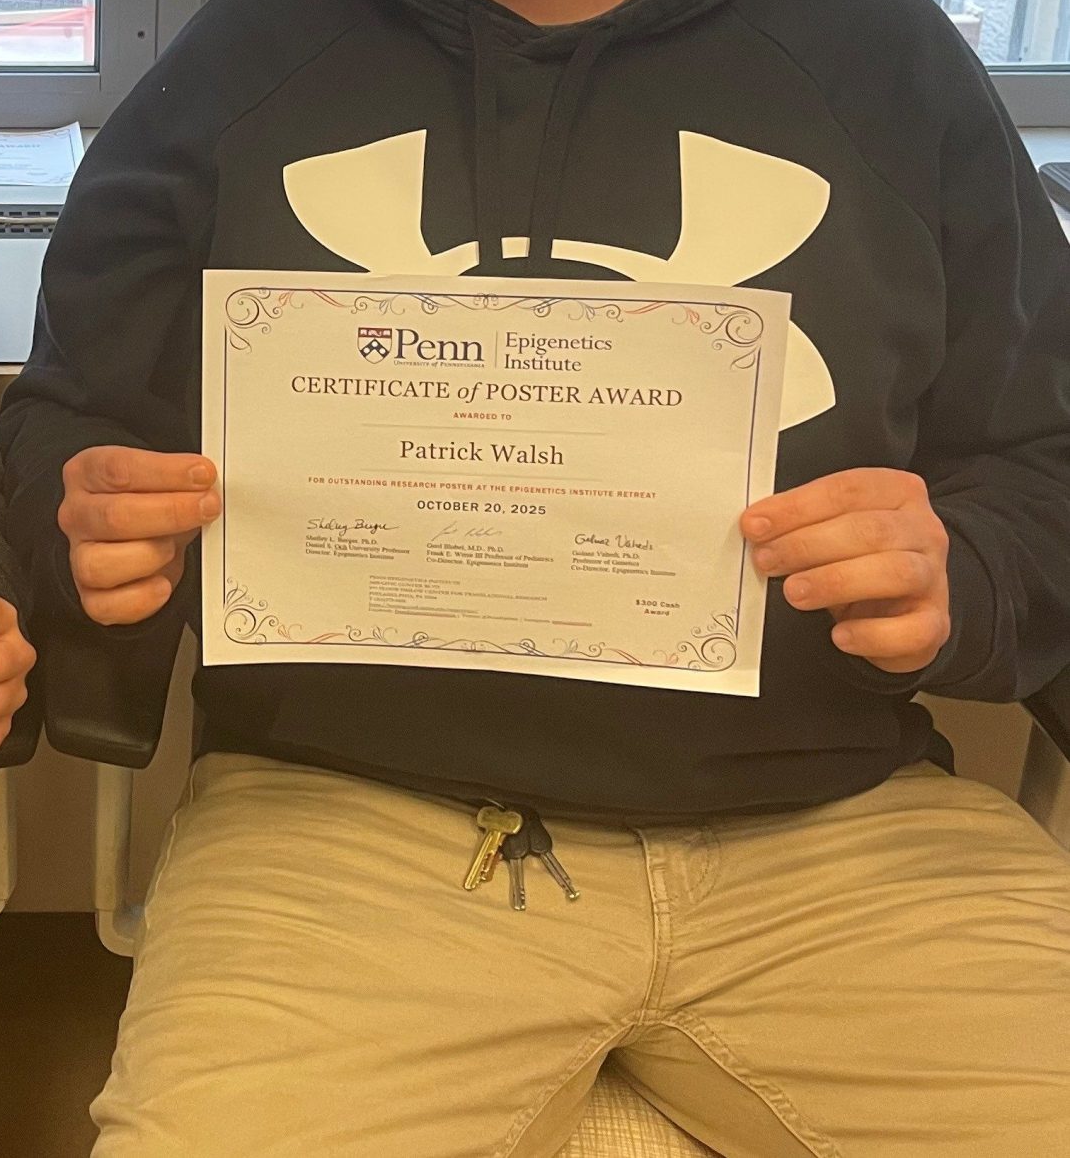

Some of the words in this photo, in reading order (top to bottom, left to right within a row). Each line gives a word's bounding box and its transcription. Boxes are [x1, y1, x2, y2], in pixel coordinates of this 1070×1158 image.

[394, 328, 485, 361] Penn
[505, 331, 613, 356] Epigenetics
[504, 354, 582, 372] Institute
[291, 375, 450, 399] CERTIFICATE
[457, 383, 483, 404] of
[486, 383, 582, 404] POSTER
[588, 387, 683, 407] AWARD
[453, 412, 498, 420] AWARDED
[500, 413, 512, 421] TO
[399, 440, 483, 462] Patrick
[490, 443, 564, 465] Walsh
[308, 476, 325, 484] FOR
[327, 477, 388, 487] OUTSTANDING
[390, 480, 437, 489] RESEARCH
[439, 482, 473, 491] POSTER
[490, 484, 506, 492] THE
[509, 485, 566, 495] EPIGENETICS
[569, 488, 614, 498] INSTITUTE
[617, 491, 657, 499] RETREAT
[417, 500, 479, 512] OCTOBER
[484, 502, 506, 515] 20,
[510, 504, 547, 515] 2025
[644, 608, 670, 617] Award
[660, 601, 681, 609] Cash
